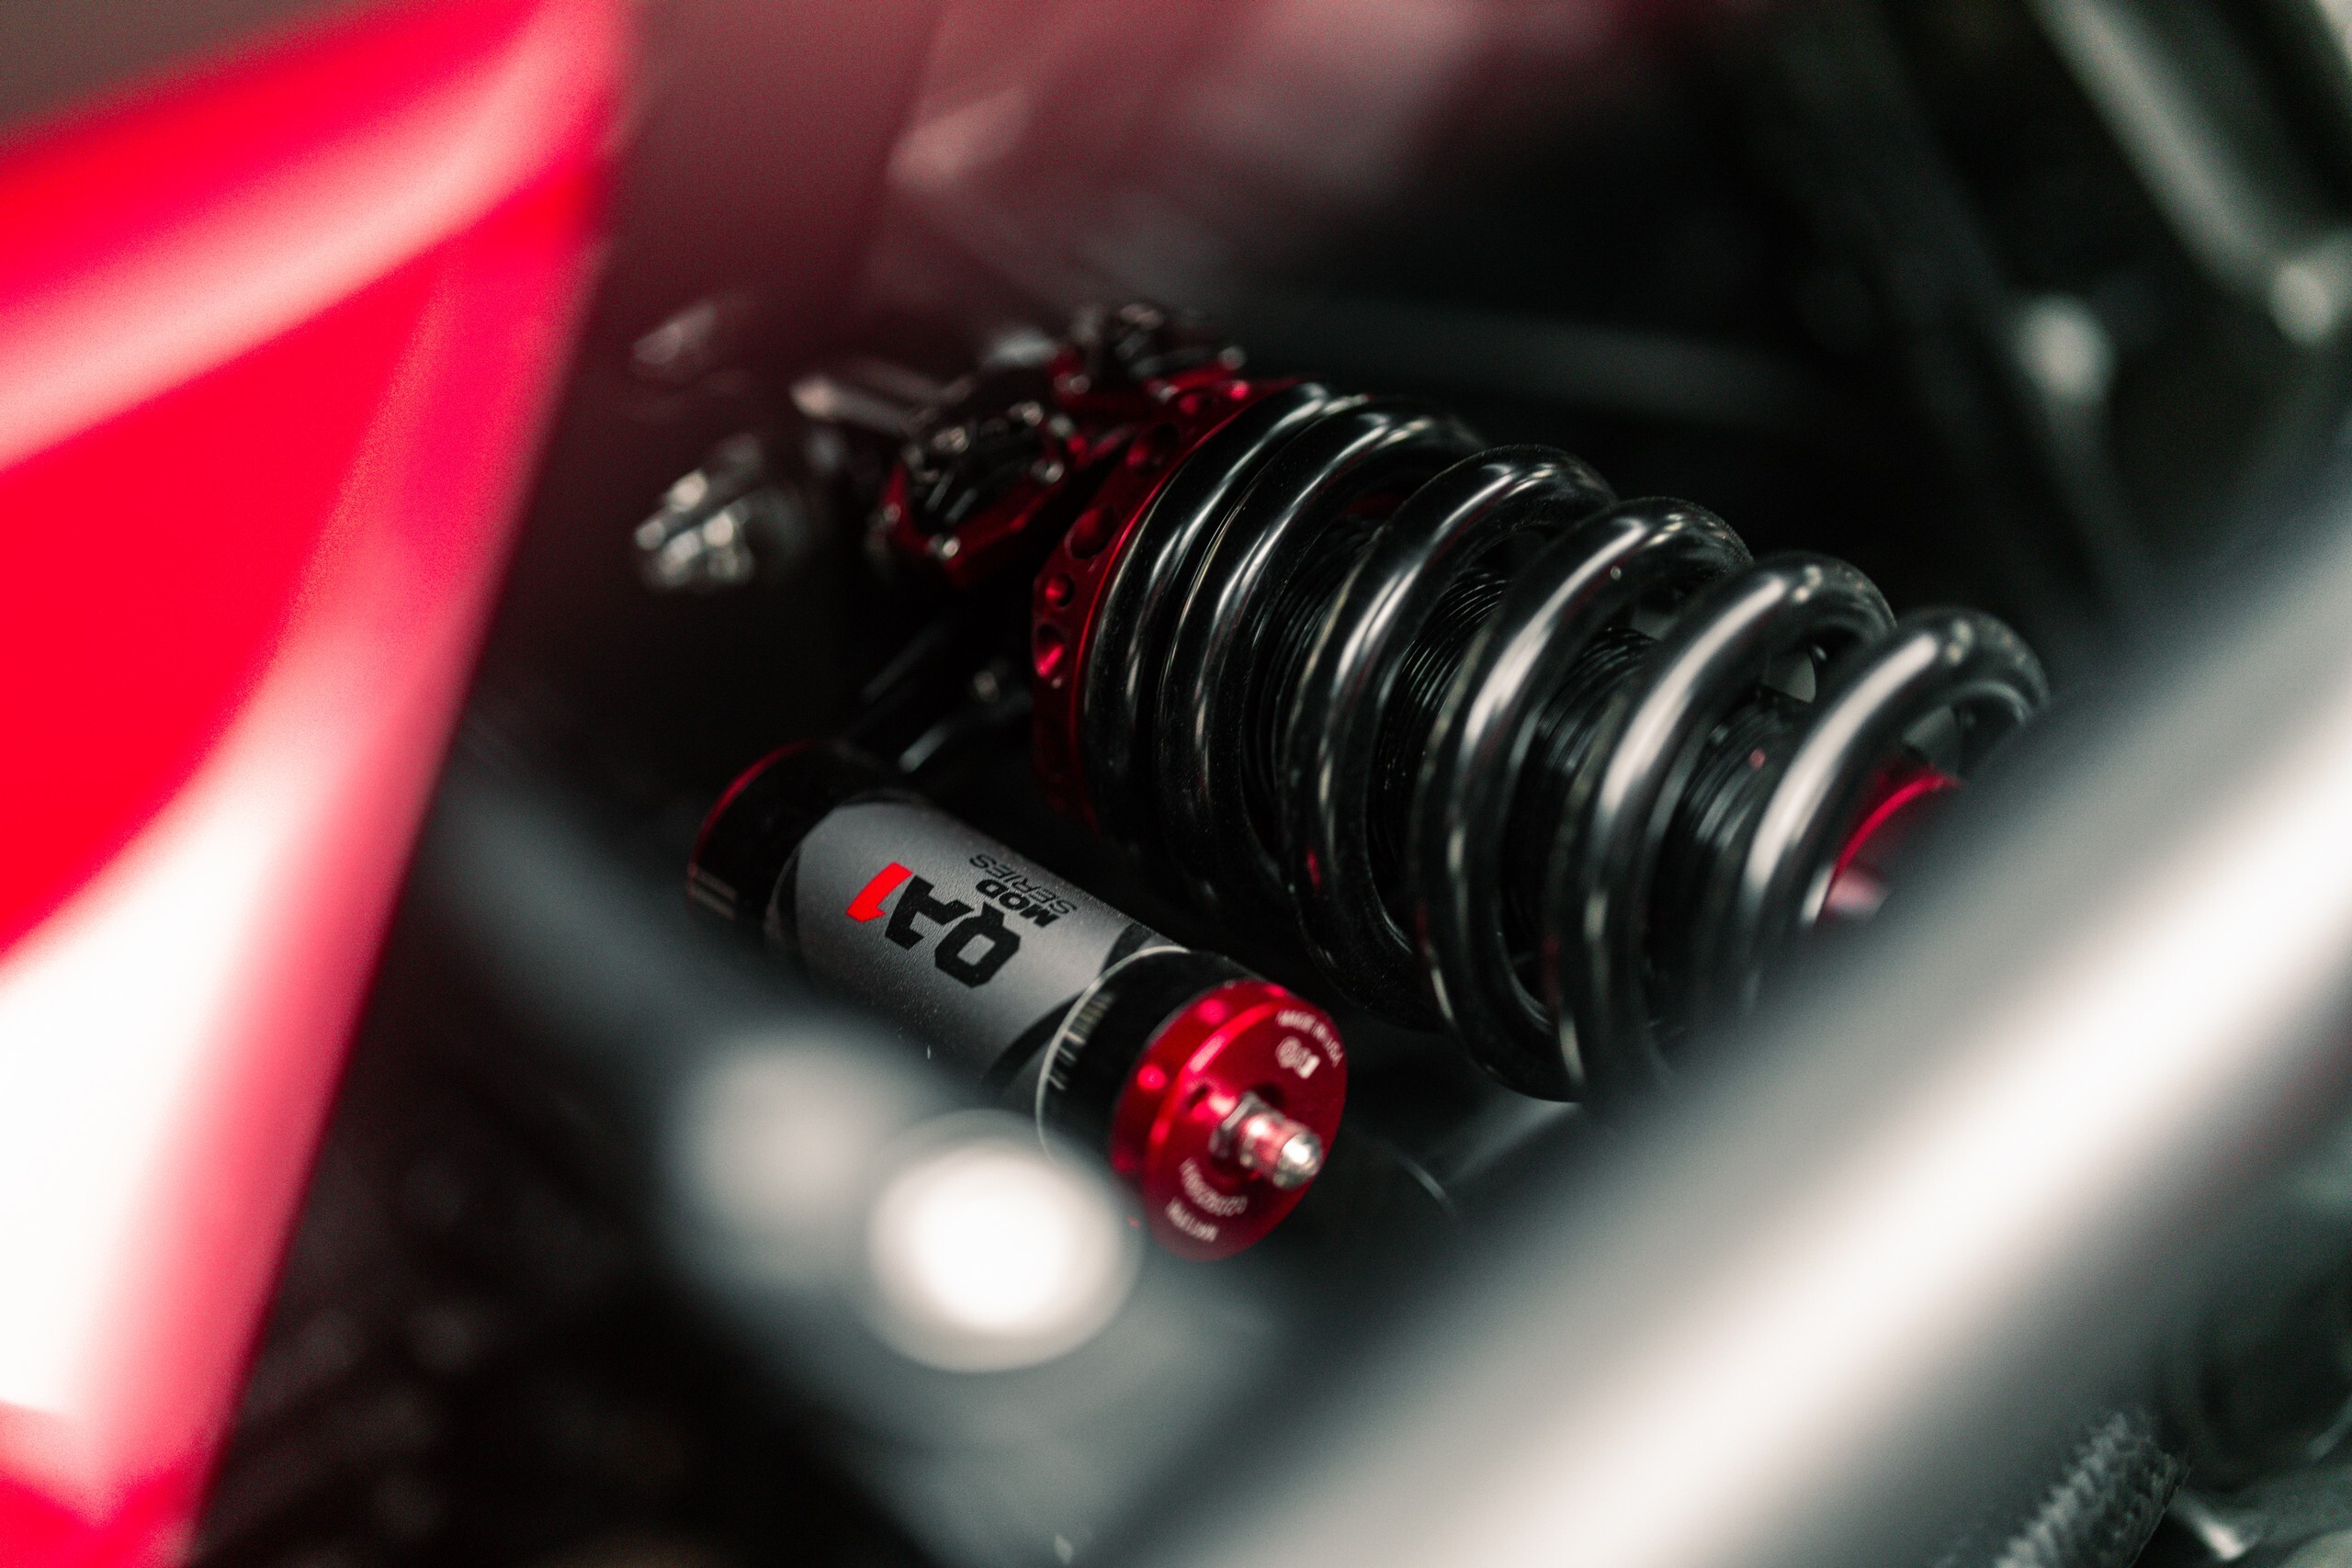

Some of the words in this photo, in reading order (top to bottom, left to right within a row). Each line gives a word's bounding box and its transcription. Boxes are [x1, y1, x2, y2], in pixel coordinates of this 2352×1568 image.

[969, 854, 1078, 914] SERIES
[975, 879, 1058, 928] MOD
[845, 862, 1021, 989] QA1
